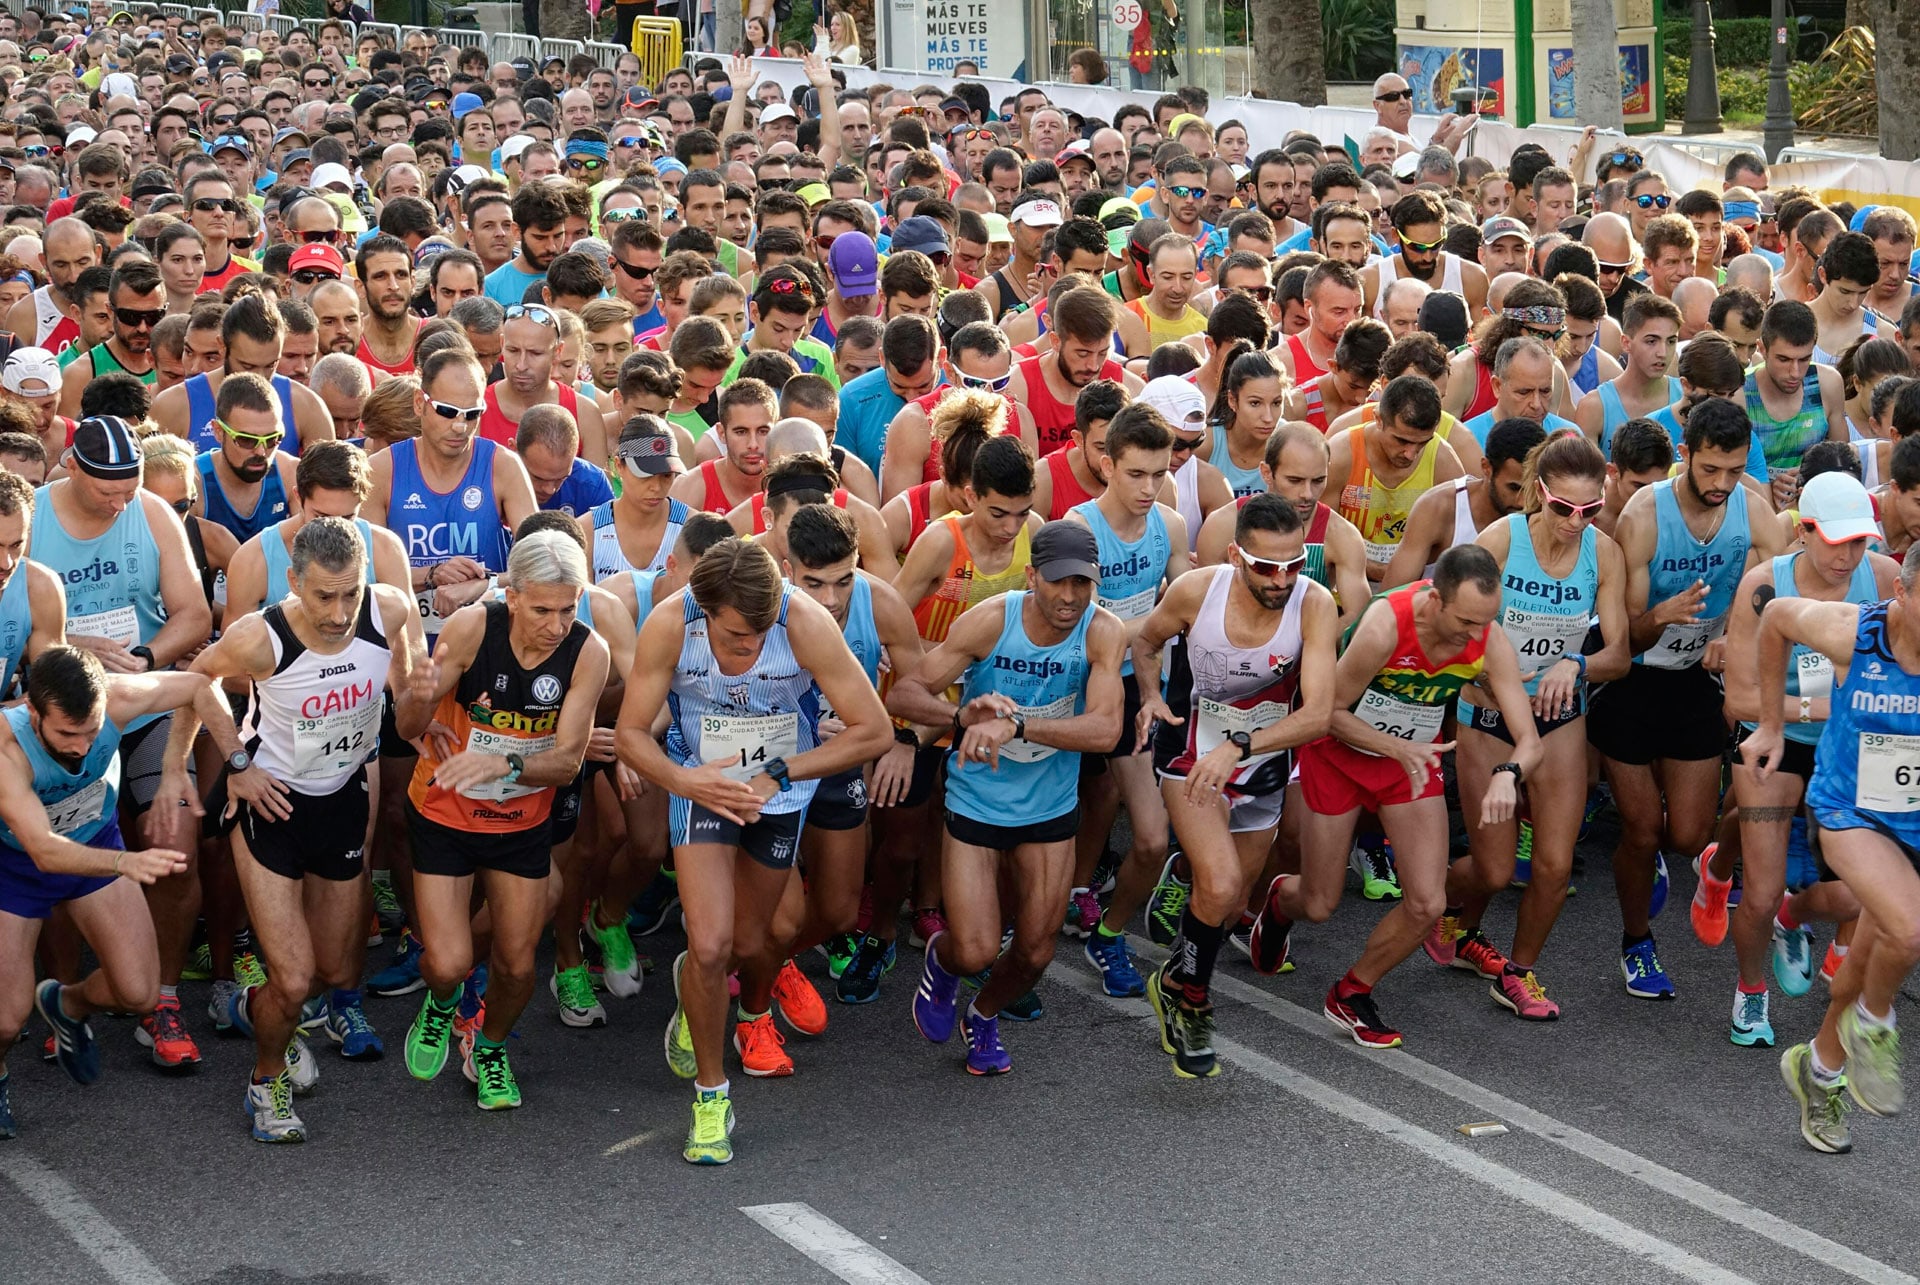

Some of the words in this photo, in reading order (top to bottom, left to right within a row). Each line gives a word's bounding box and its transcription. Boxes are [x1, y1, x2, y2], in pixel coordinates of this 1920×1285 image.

[927, 2, 958, 18] MÁS
[968, 5, 987, 17] TE
[1114, 5, 1140, 24] 35
[927, 22, 987, 36] MUEVES
[928, 37, 960, 53] MÁS
[969, 39, 987, 52] TE
[928, 56, 988, 71] PROGE
[272, 502, 285, 514] NB
[407, 522, 478, 556] RCM
[1099, 553, 1151, 579] nerja
[1662, 552, 1724, 573] nerja
[1504, 574, 1582, 605] nerja
[1509, 598, 1571, 615] ATLETISMO
[76, 624, 99, 633] CIUDAD
[101, 622, 109, 630] DE
[77, 616, 106, 625] CARRERA
[1520, 638, 1565, 656] 403
[1667, 634, 1709, 653] 443
[319, 662, 356, 679] Joma
[993, 655, 1065, 679] nerja
[301, 678, 373, 719] CAIM
[1851, 689, 1920, 714] MARB
[765, 716, 793, 724] URBANA
[321, 731, 364, 756] 142
[534, 742, 554, 750] MÁLAG
[741, 746, 767, 768] 14
